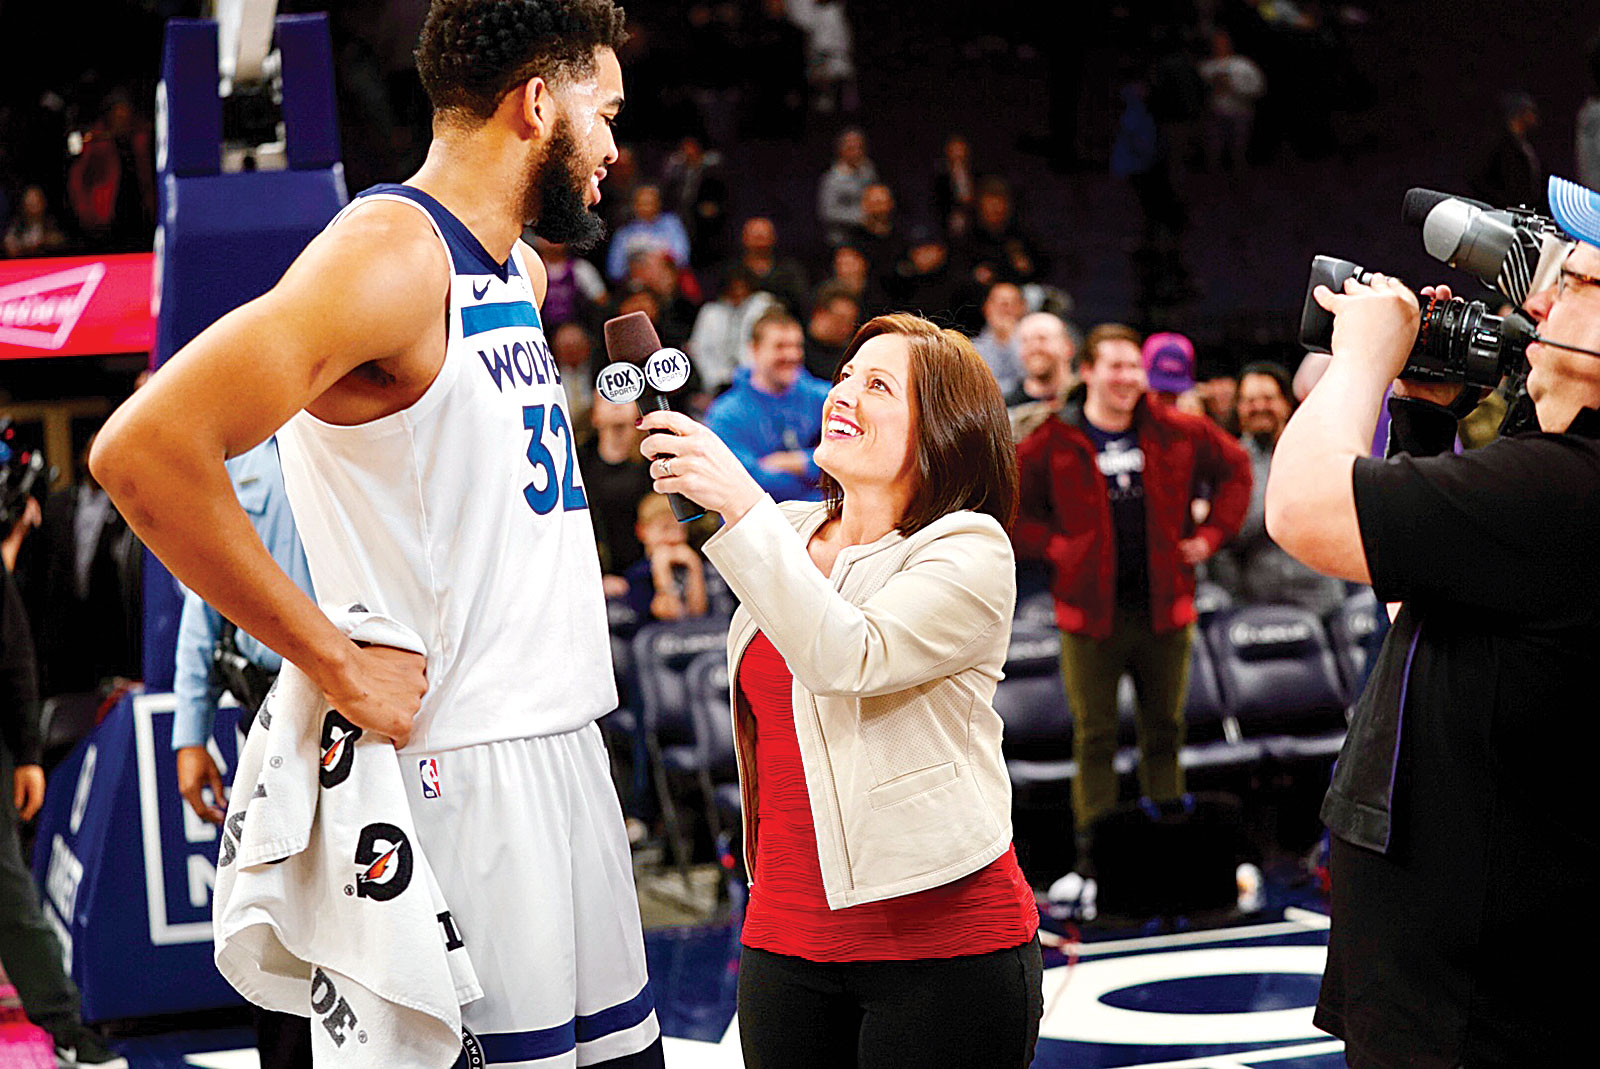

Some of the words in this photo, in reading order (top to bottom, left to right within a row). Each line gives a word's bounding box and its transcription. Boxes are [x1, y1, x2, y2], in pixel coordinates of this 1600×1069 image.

[653, 356, 680, 377] FOX
[605, 369, 634, 391] FOX
[657, 372, 683, 385] SPORTS
[609, 386, 638, 398] SPORTS
[522, 403, 588, 515] 32
